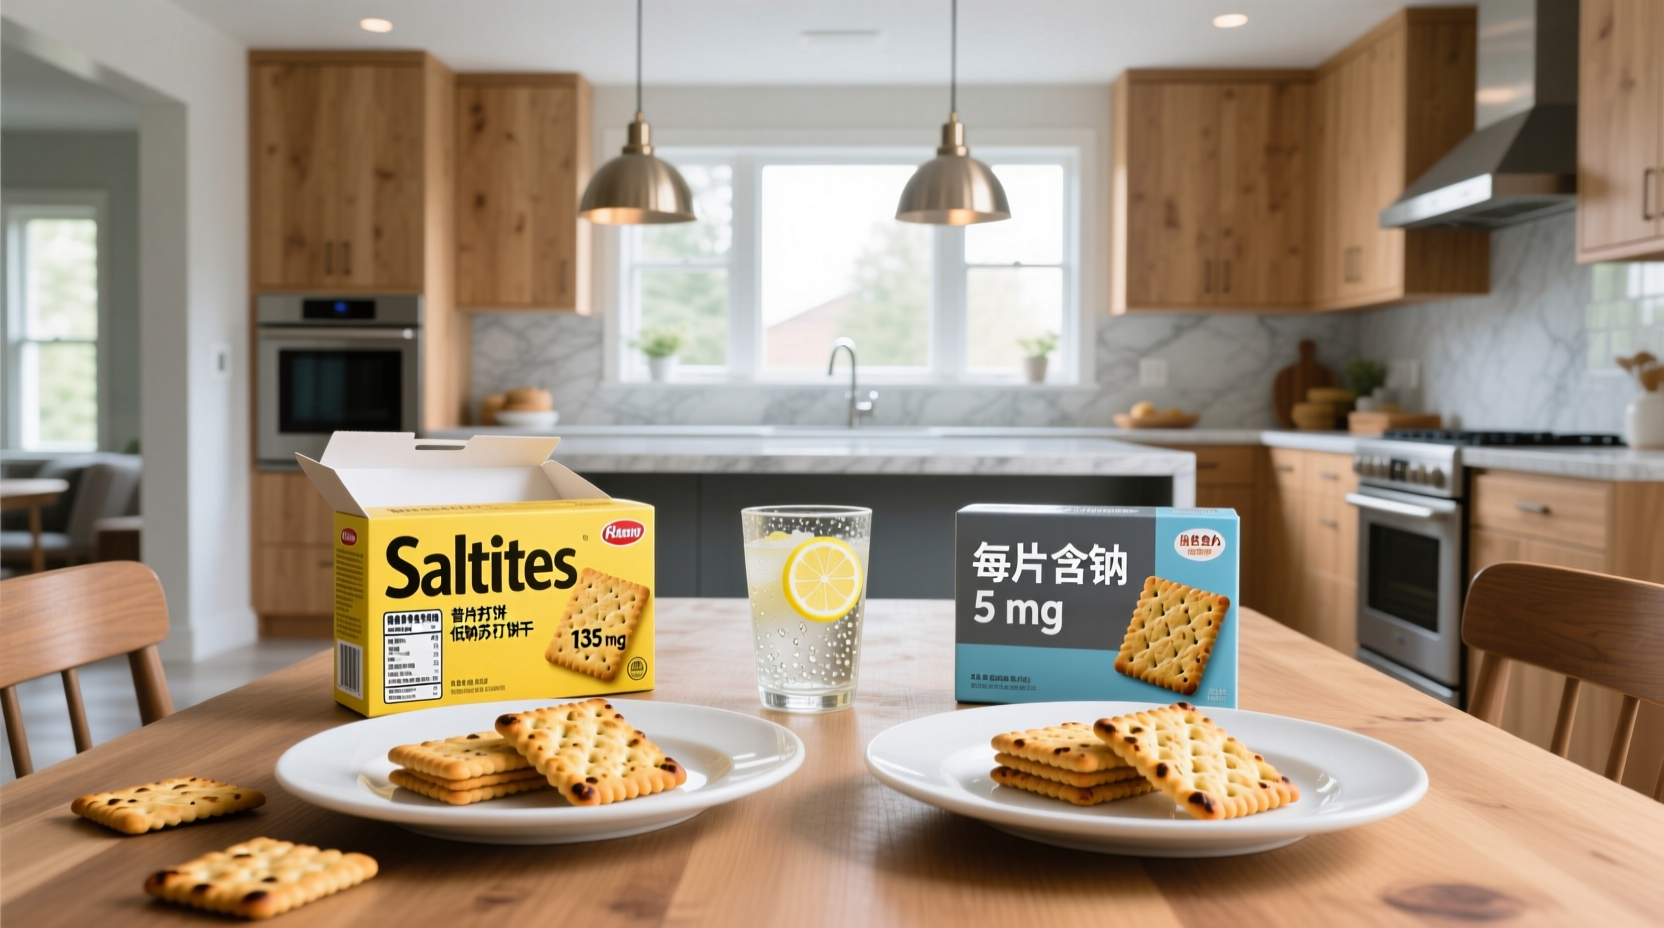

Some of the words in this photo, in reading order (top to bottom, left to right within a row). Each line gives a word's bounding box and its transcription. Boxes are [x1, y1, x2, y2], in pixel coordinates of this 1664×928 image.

[385, 535, 577, 599] Saltites
[972, 541, 1128, 586] 每片含钠
[974, 589, 996, 624] 5
[1006, 599, 1063, 635] mg
[571, 628, 602, 649] 135
[605, 633, 627, 651] mg
